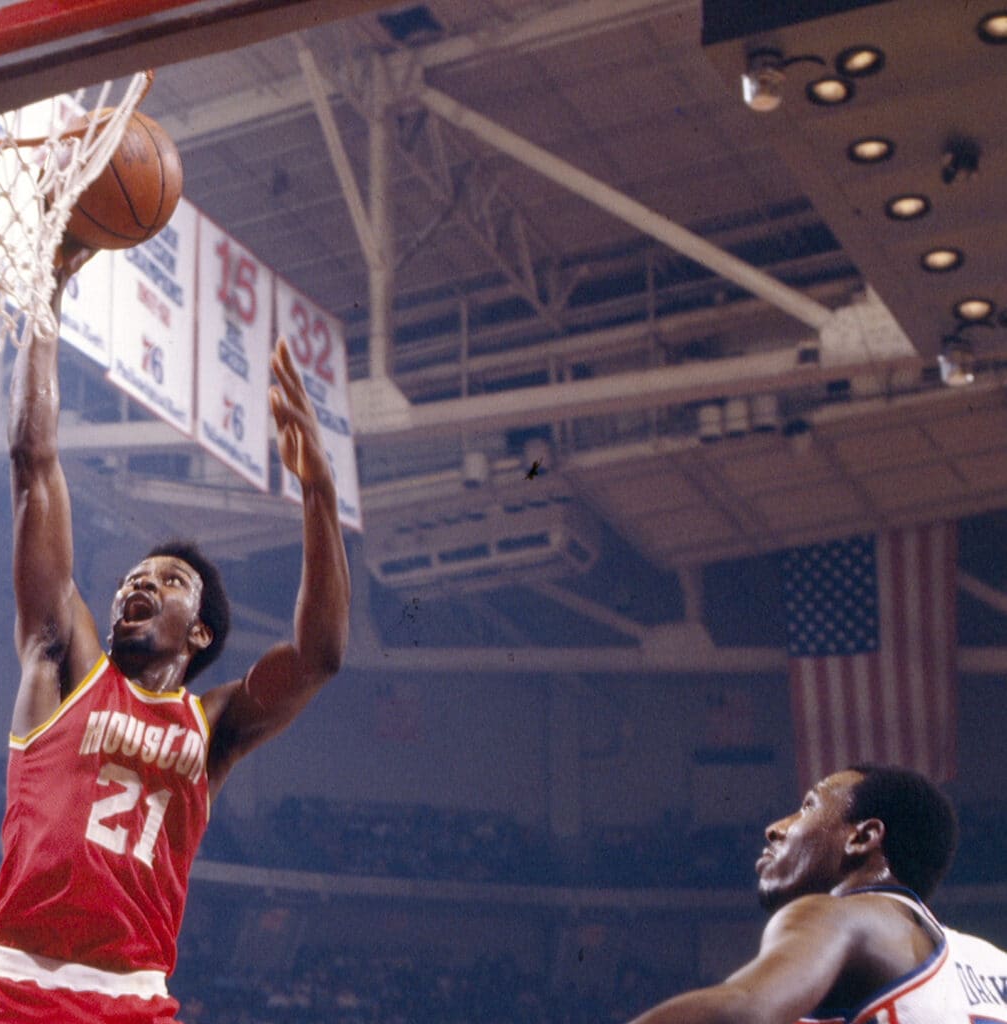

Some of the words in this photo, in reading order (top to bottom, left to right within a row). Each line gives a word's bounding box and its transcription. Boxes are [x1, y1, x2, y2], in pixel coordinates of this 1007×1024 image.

[215, 239, 257, 325] 15
[140, 334, 165, 385] 76
[290, 301, 335, 385] 32
[222, 395, 244, 443] 76
[85, 761, 173, 869] 21
